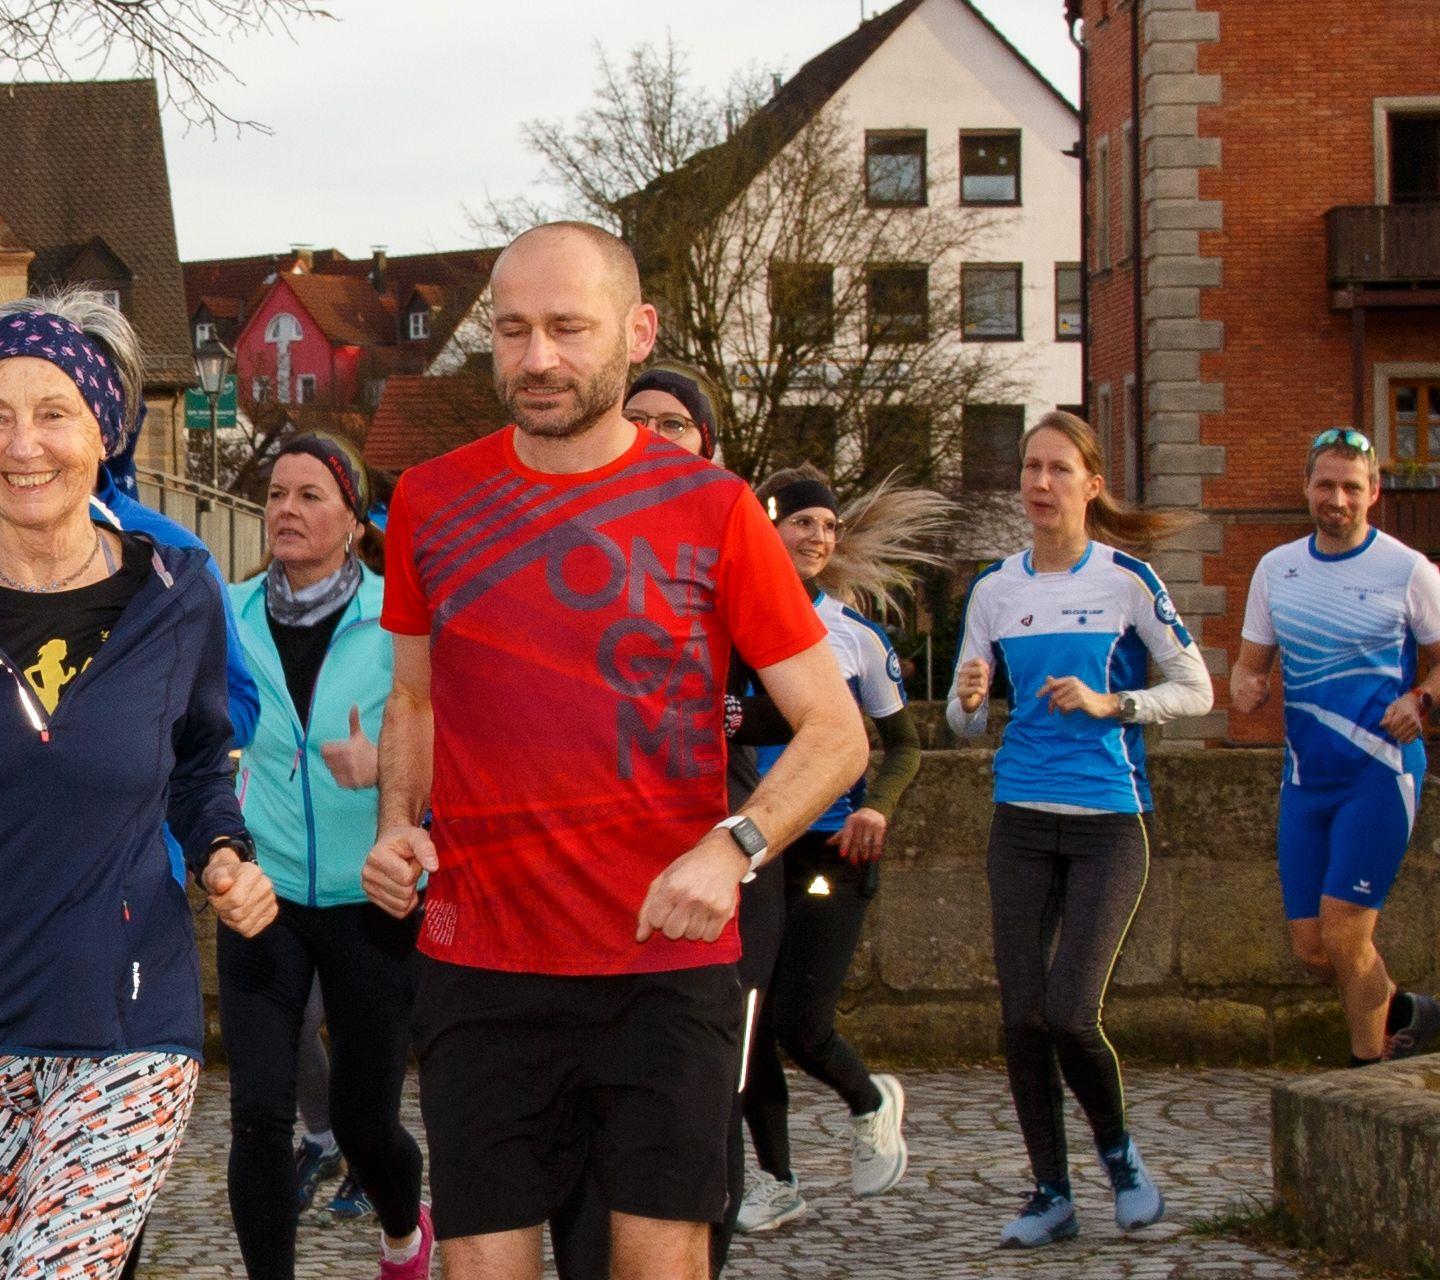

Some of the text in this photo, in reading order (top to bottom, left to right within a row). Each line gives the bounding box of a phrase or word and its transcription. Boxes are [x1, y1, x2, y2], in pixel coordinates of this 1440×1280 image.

[545, 521, 720, 617] ONE
[596, 617, 714, 697] GA
[616, 699, 717, 780] ME
